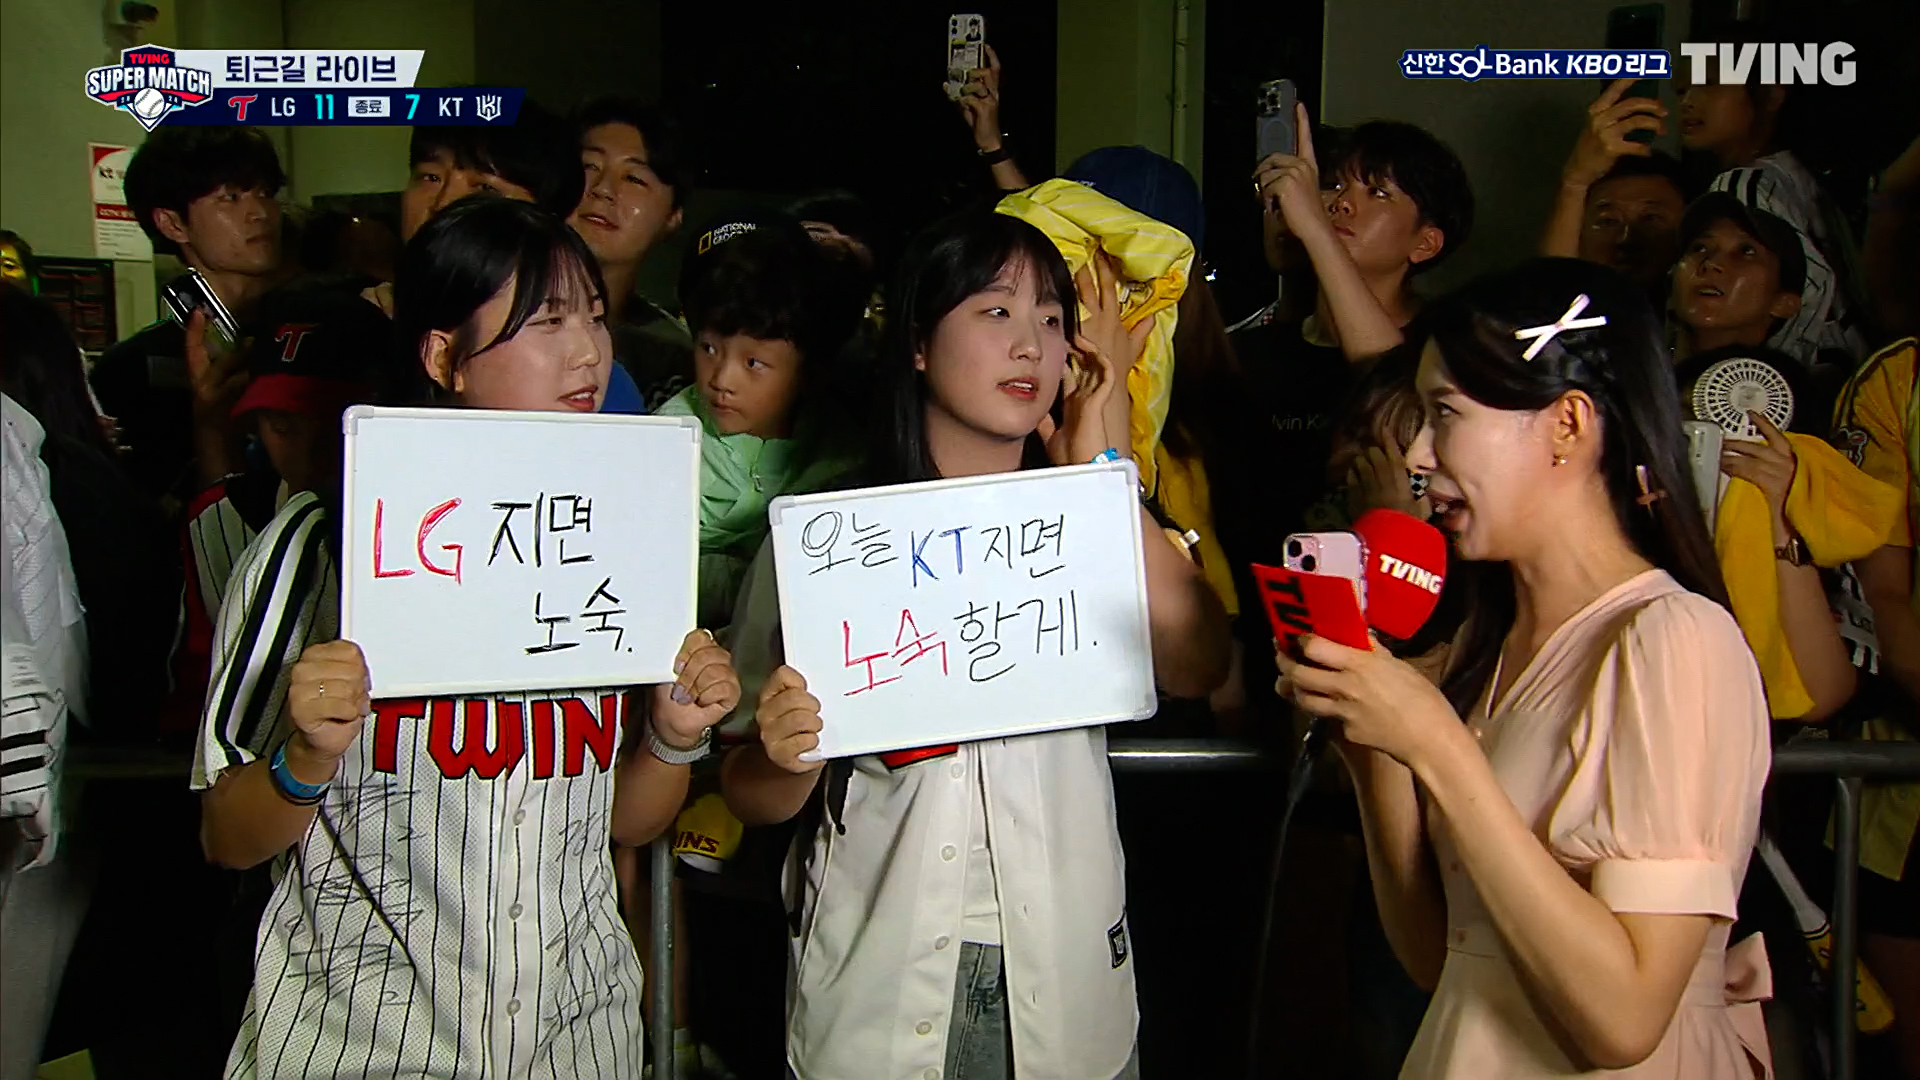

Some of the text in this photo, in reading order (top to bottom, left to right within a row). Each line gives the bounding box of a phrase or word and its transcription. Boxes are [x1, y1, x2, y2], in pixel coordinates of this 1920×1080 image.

[373, 491, 596, 585] LG 지면
[801, 510, 1066, 588] 오늘 KT 지면
[1379, 553, 1444, 595] TVING
[524, 576, 634, 656] 노숙.
[843, 608, 949, 696] 노숙
[371, 693, 630, 781] TWIN
[672, 830, 720, 853] INS
